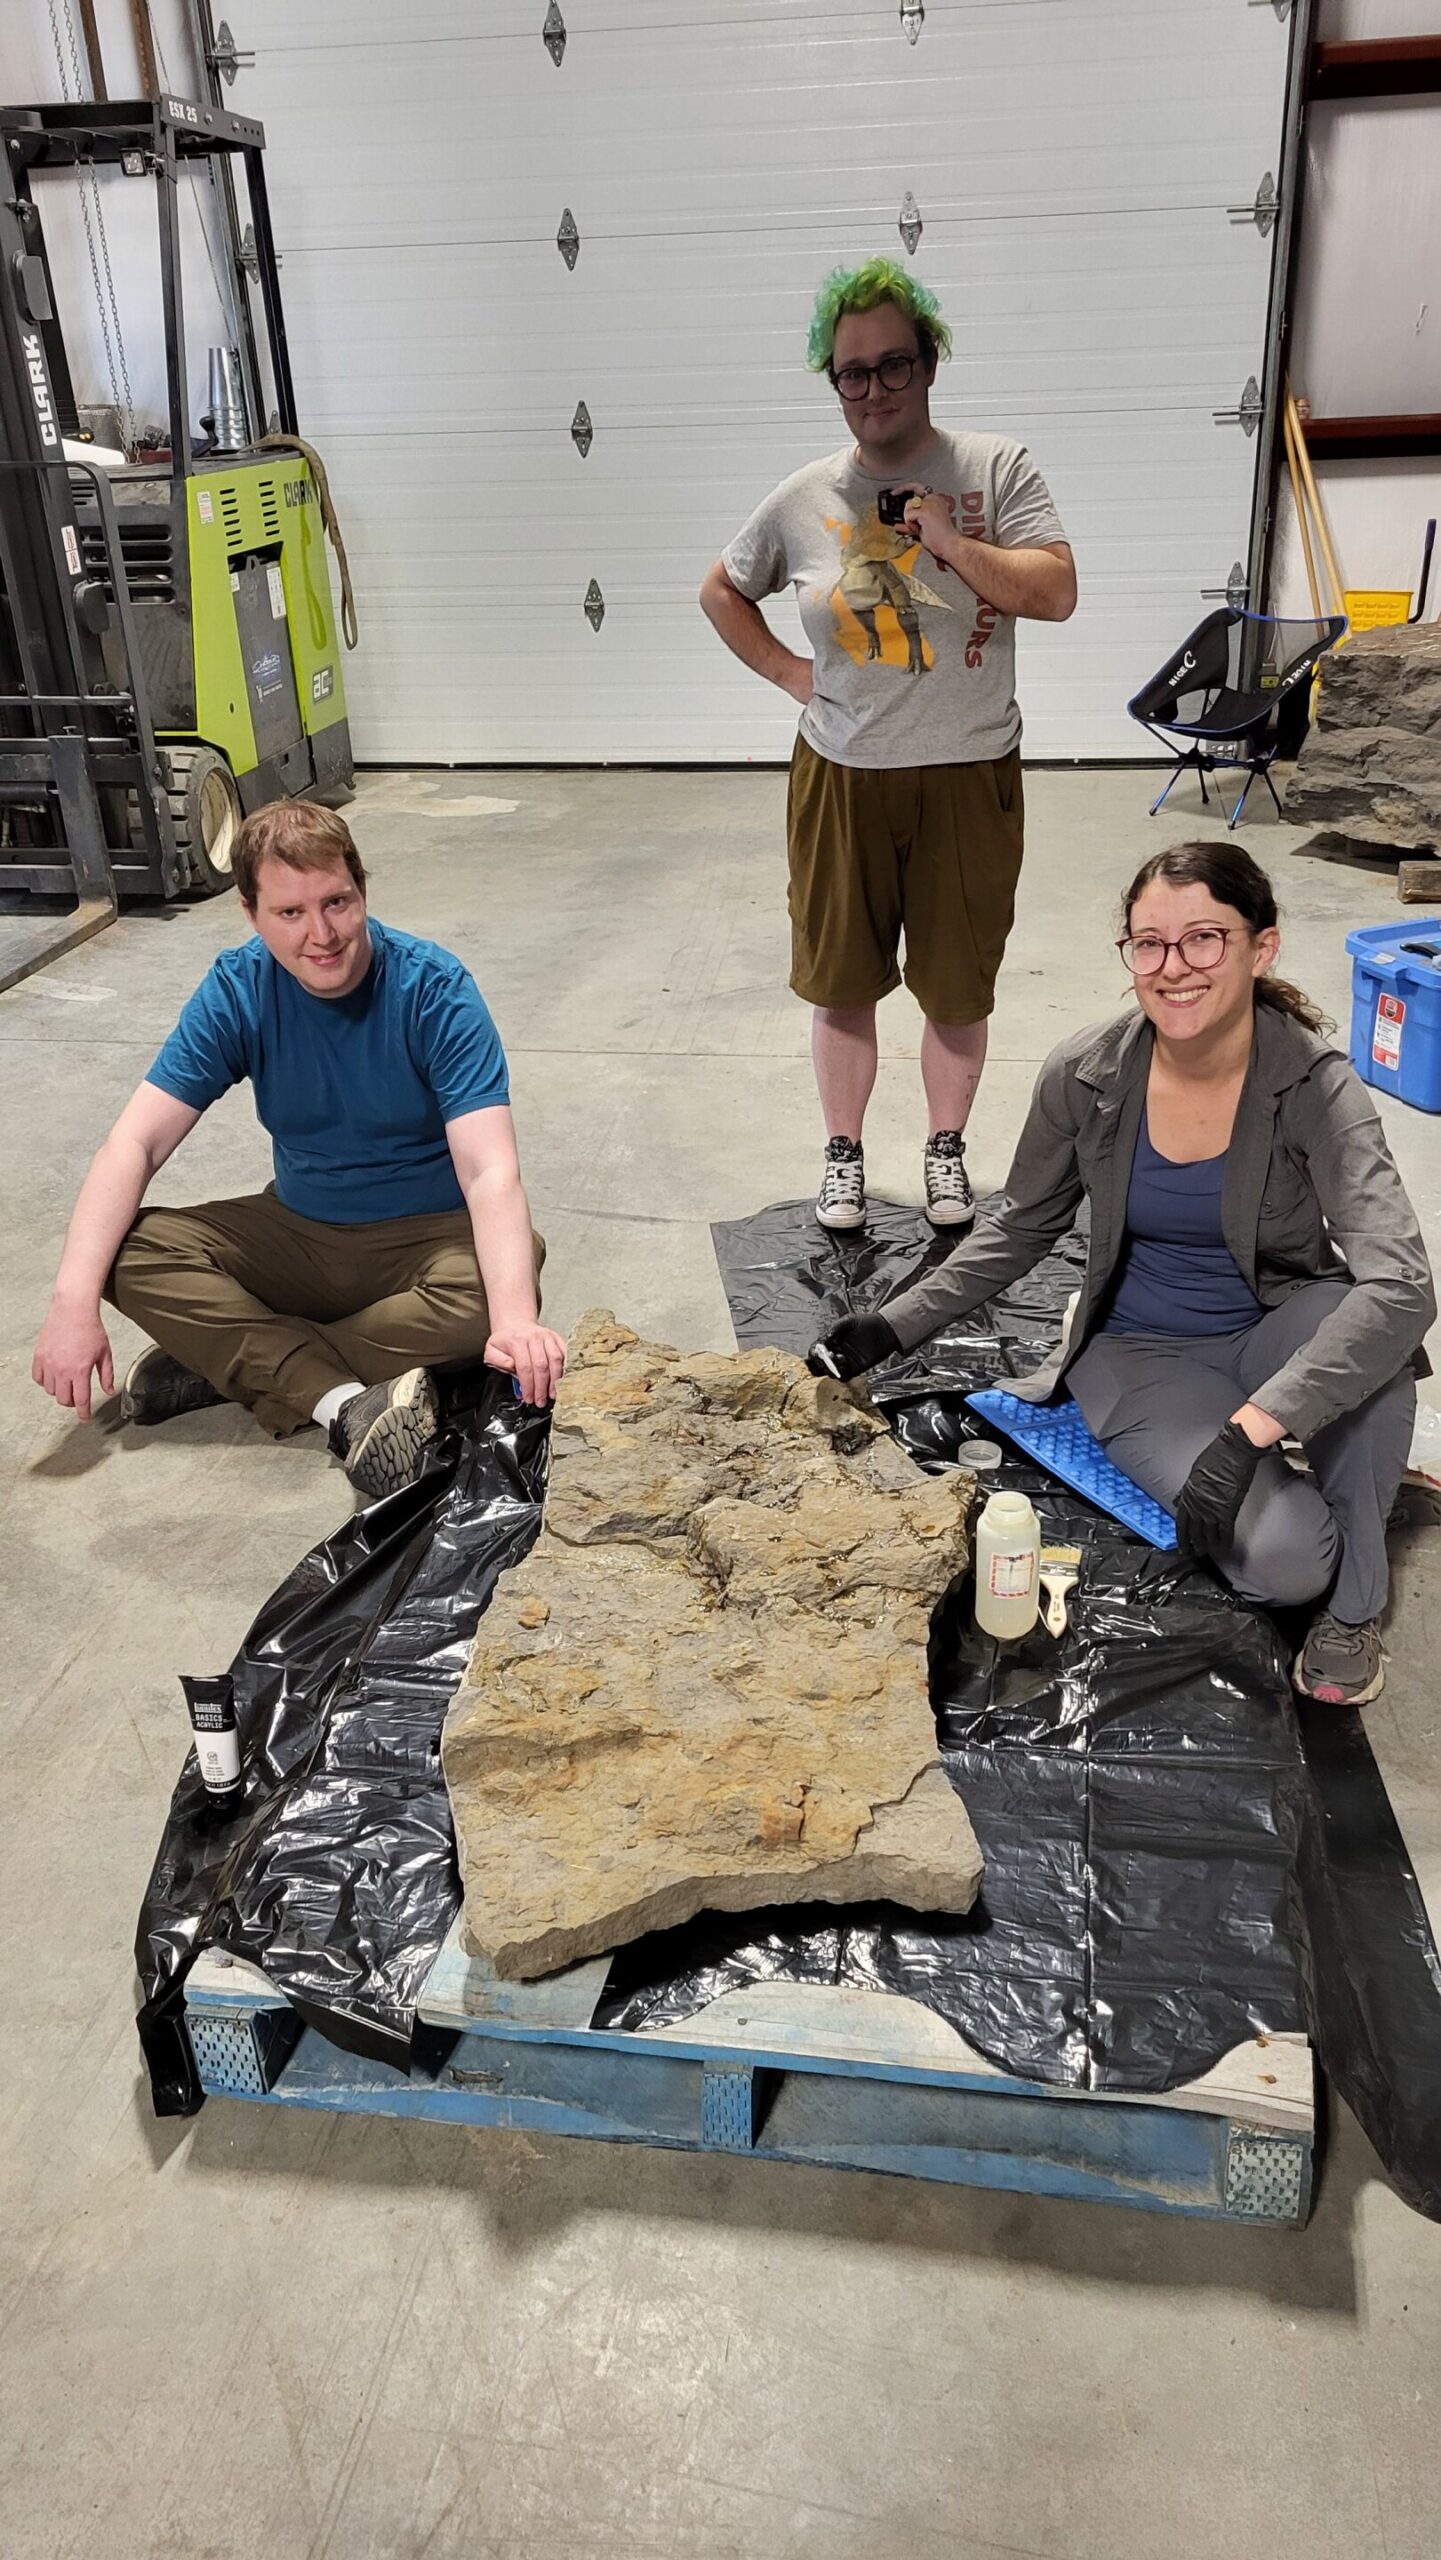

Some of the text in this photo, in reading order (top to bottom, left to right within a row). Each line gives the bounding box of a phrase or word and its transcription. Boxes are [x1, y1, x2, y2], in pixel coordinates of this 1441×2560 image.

[168, 100, 198, 124] ESX 25
[22, 334, 58, 446] CLARK
[283, 479, 314, 508] CLARK
[195, 1713, 223, 1722] BASICS
[196, 1721, 223, 1729] ACRYLIC
